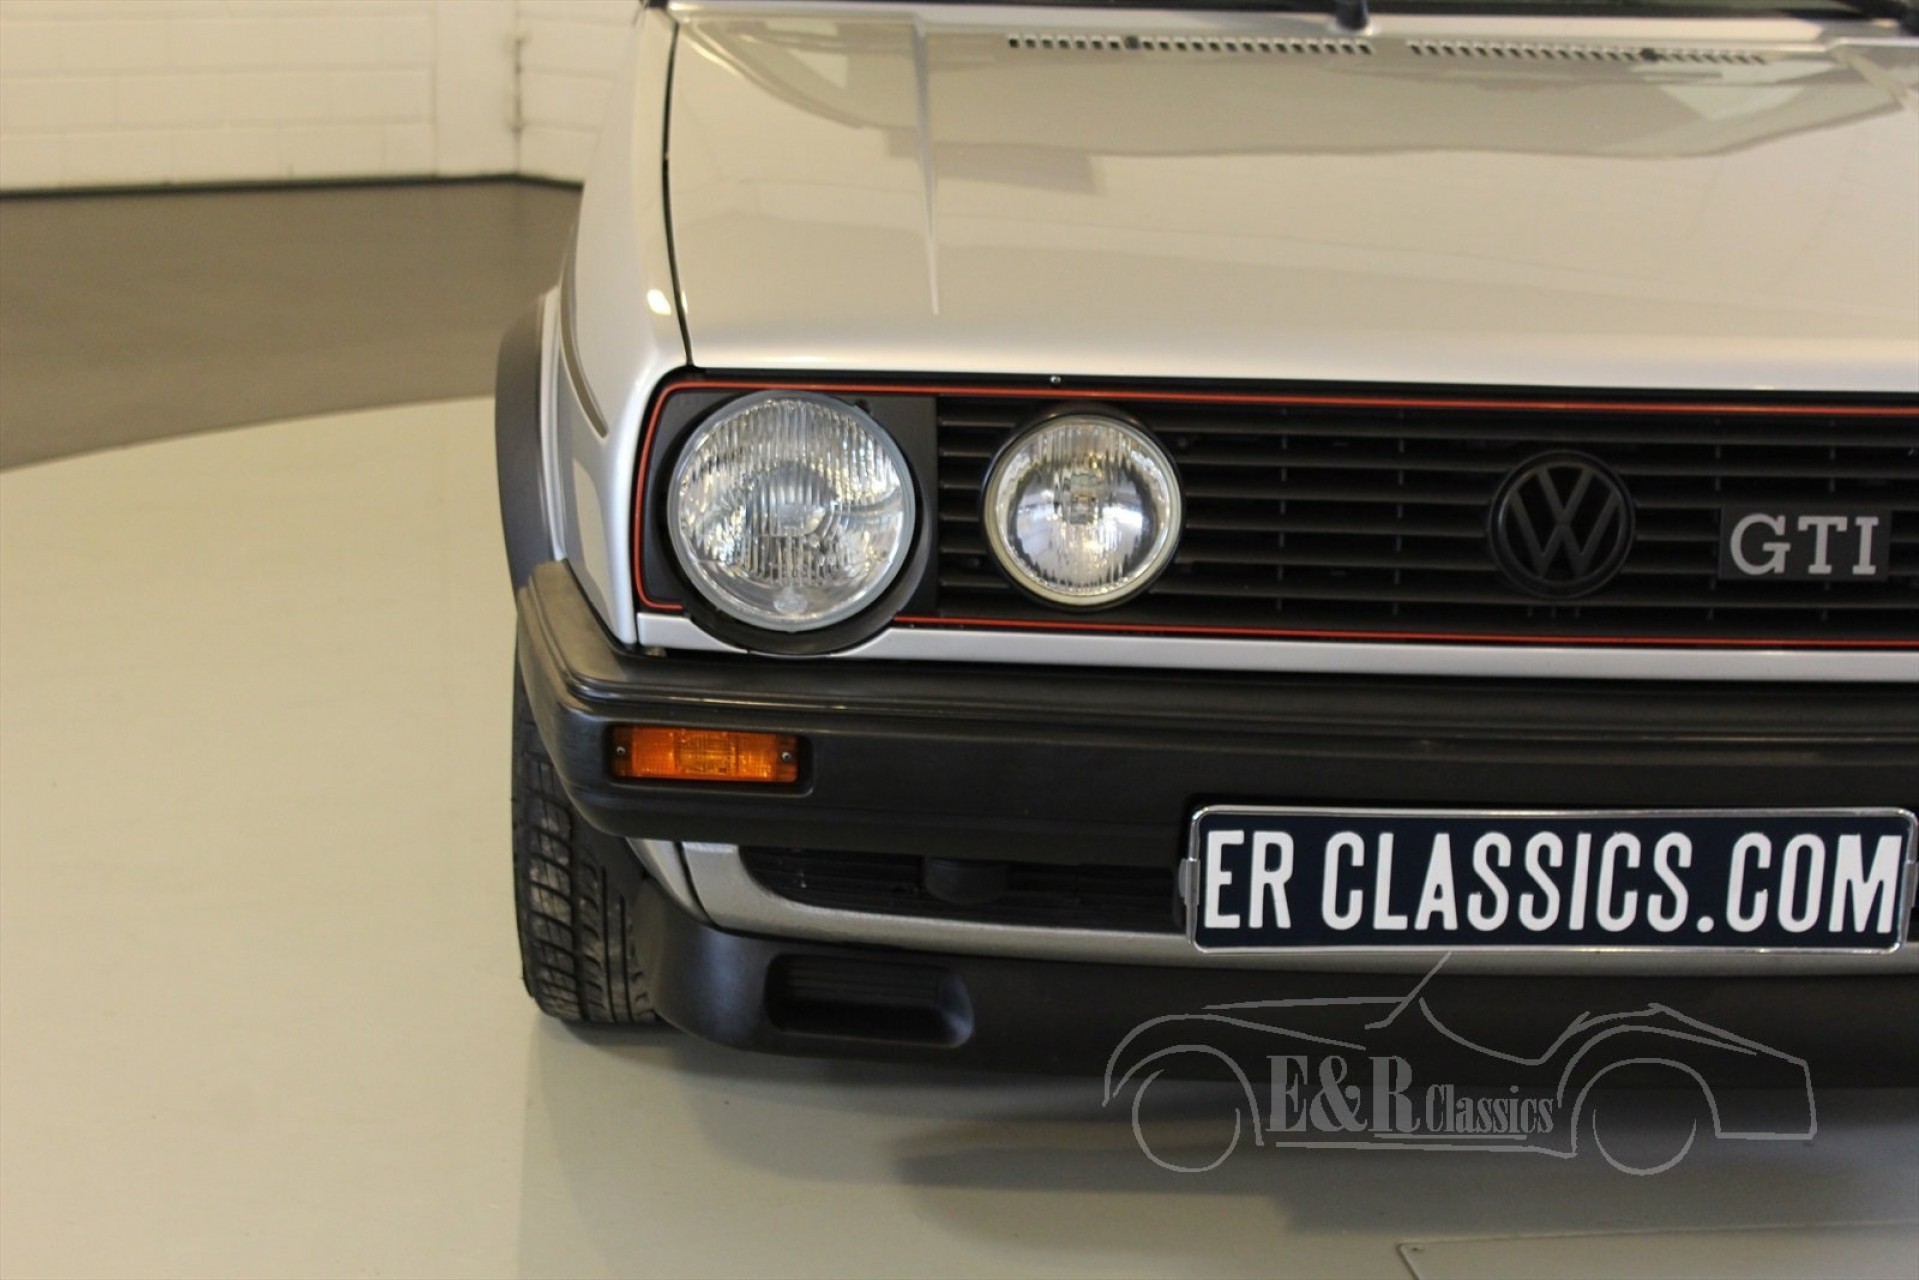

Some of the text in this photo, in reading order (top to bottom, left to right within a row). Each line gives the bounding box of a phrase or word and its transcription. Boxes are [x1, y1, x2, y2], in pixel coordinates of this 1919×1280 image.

[1730, 512, 1879, 575] GTI
[1204, 829, 1902, 934] ER CLASSICS.COM
